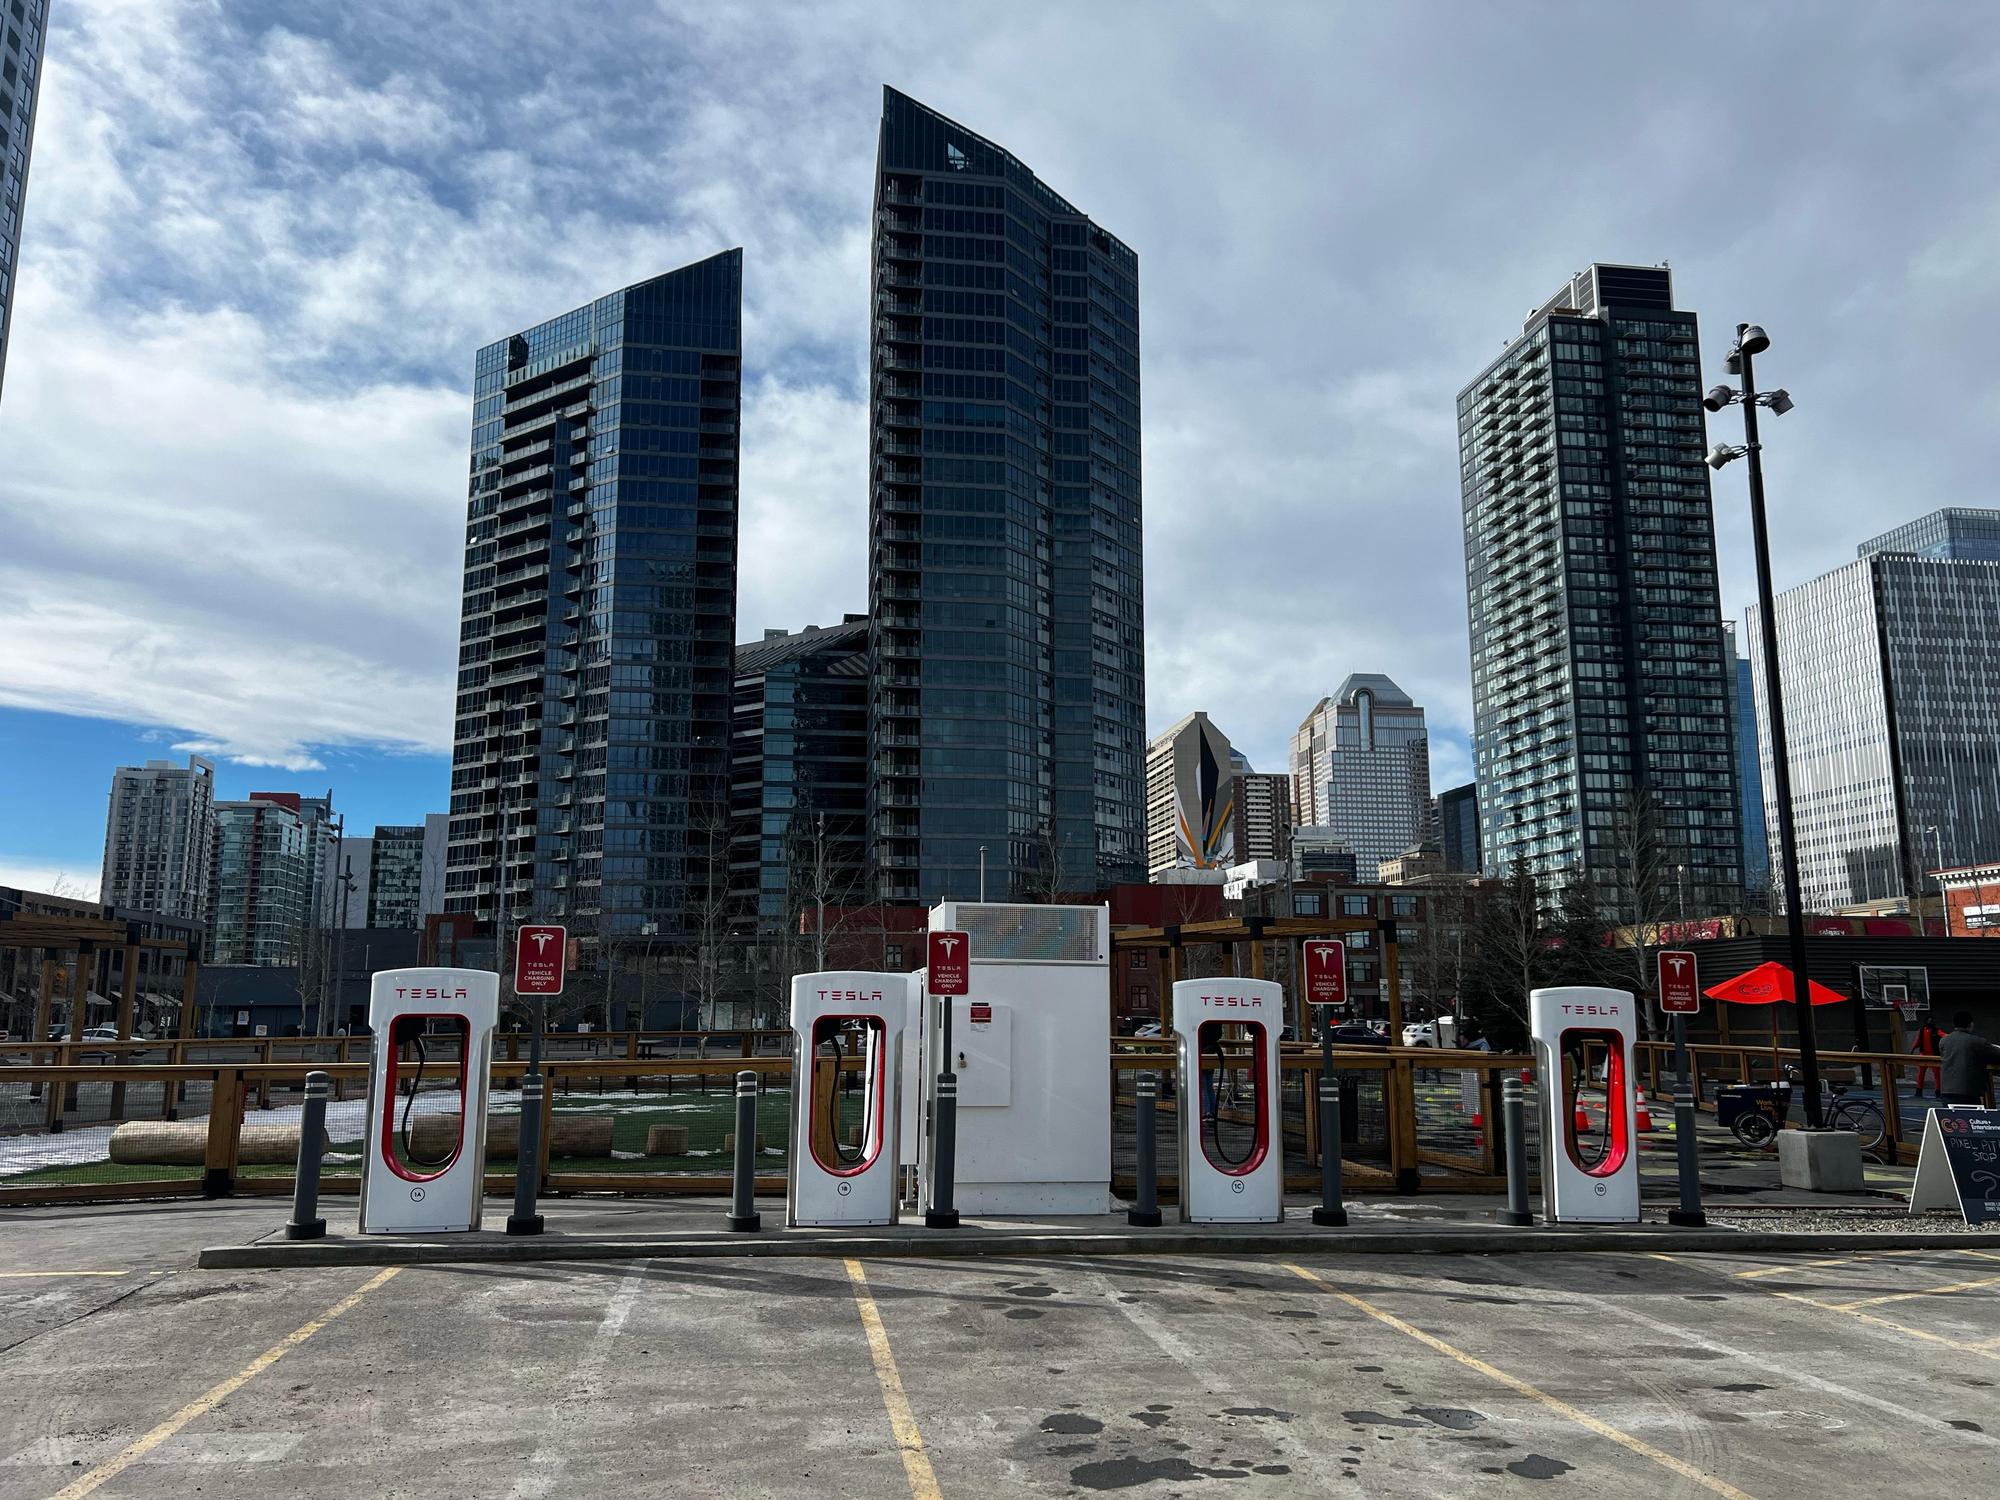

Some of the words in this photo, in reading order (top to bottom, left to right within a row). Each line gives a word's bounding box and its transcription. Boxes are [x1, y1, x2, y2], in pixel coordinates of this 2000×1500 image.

[396, 988, 467, 999] TESLA
[817, 990, 882, 1001] TESLA
[1200, 996, 1262, 1007] TESLA
[1561, 1005, 1619, 1016] TESLA
[1972, 1152, 1997, 1162] STOP
